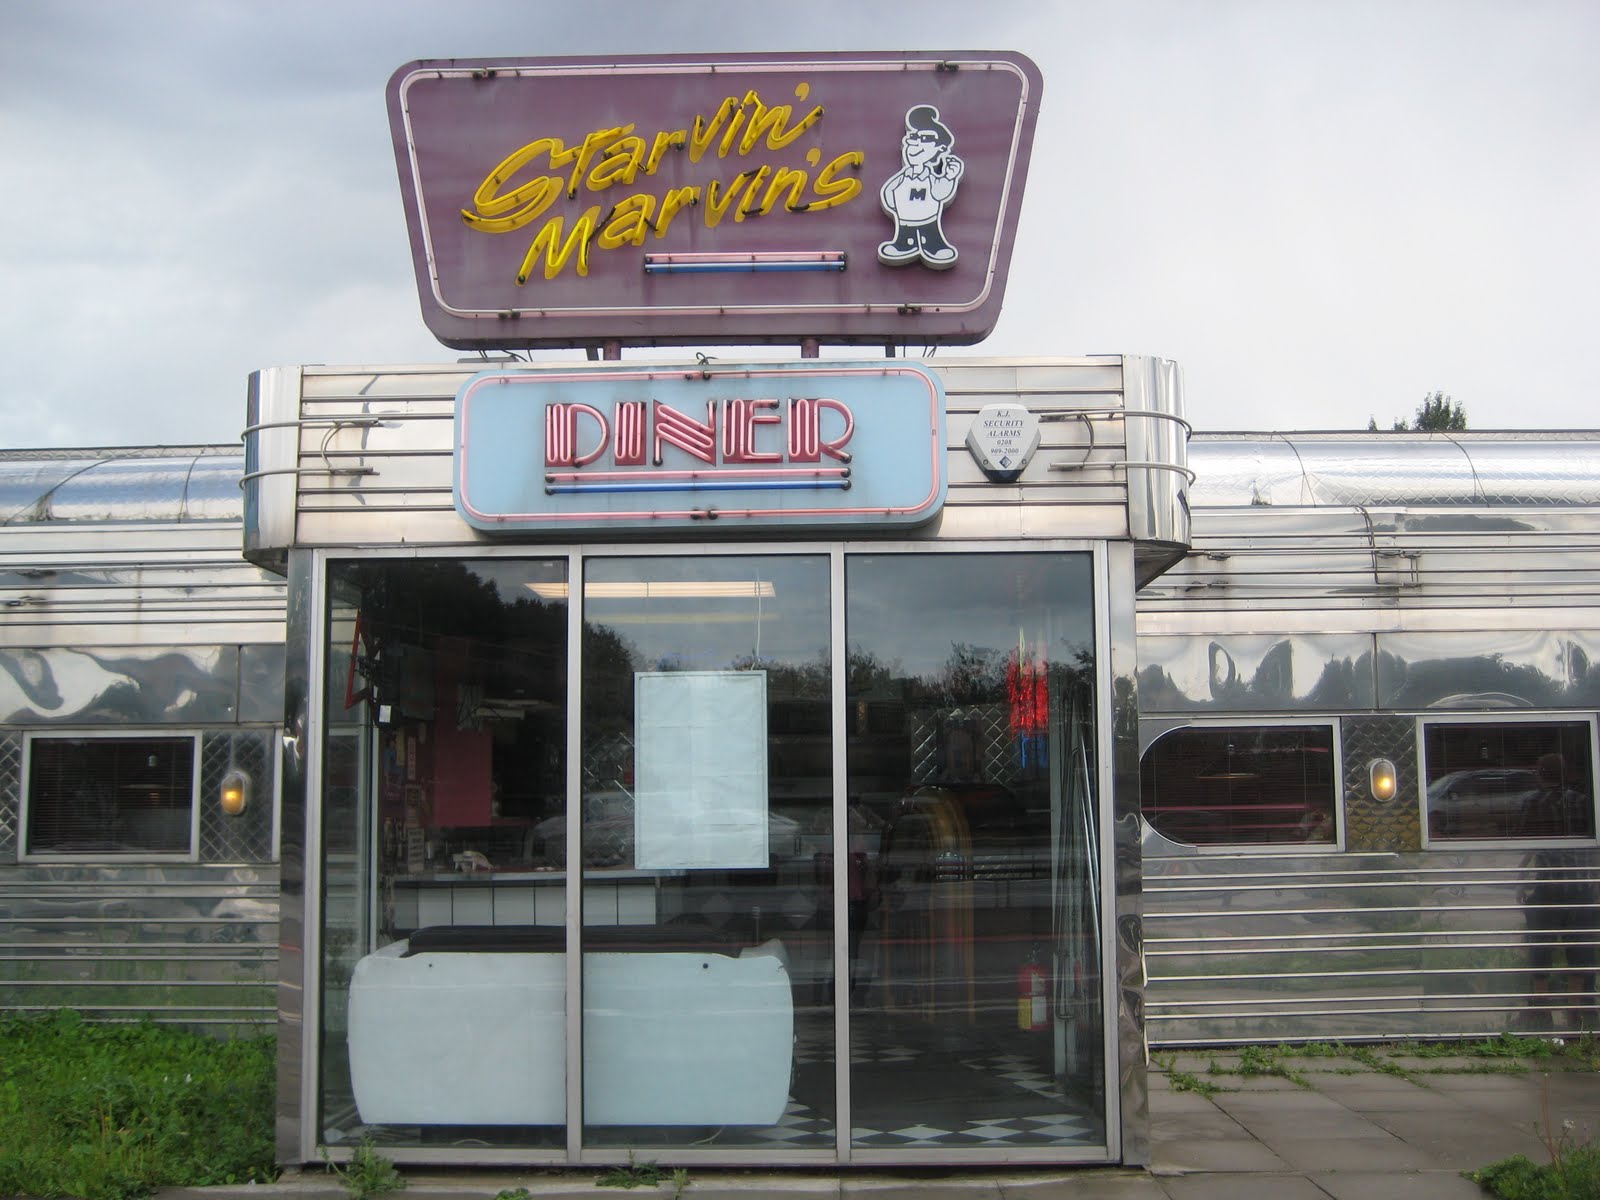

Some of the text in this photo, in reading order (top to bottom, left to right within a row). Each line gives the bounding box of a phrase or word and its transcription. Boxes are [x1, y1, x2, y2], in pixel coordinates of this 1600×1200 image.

[461, 82, 824, 234] Starvin'
[515, 147, 865, 286] Marvin's
[544, 397, 855, 468] DINER
[983, 420, 1025, 428] SECURITY
[987, 429, 1022, 437] ALARMS
